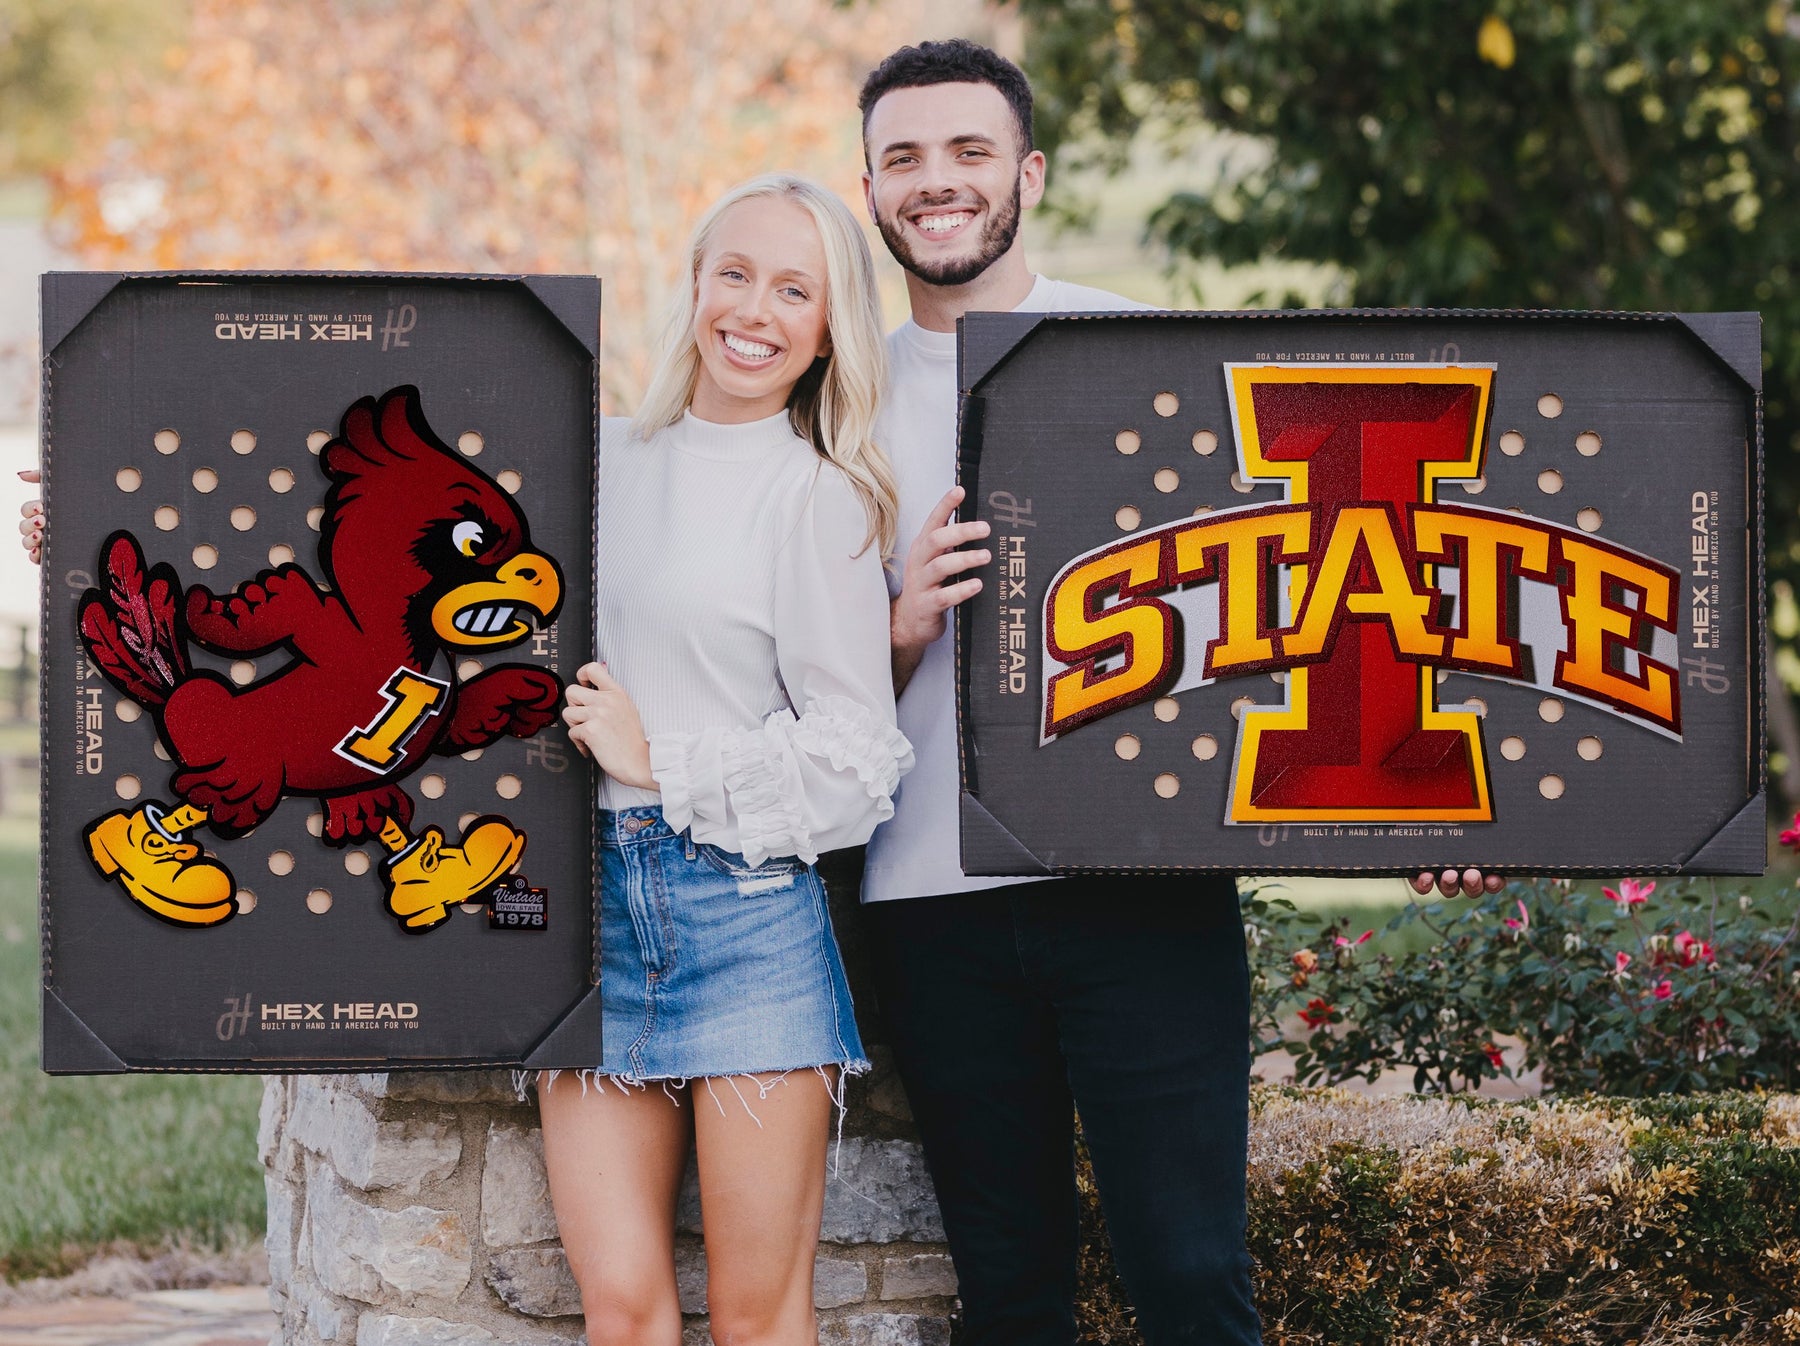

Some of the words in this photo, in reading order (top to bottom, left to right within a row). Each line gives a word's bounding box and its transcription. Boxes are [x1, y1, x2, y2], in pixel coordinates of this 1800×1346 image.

[214, 313, 230, 322] YOU
[234, 313, 250, 322] FOR
[254, 313, 289, 322] AMERICA
[293, 313, 303, 322] IN
[308, 313, 328, 322] HAND
[333, 313, 343, 322] BY
[348, 313, 373, 322] BUILT
[215, 323, 300, 340] HEAD
[310, 324, 372, 341] HEX
[1255, 352, 1271, 361] YOU
[1275, 352, 1291, 361] FOR
[1296, 352, 1330, 361] AMERICA
[1335, 352, 1345, 361] IN
[1350, 352, 1370, 361] HAND
[1375, 352, 1385, 361] BY
[1390, 352, 1415, 361] BUILT
[1711, 491, 1720, 506] YOU
[1711, 510, 1720, 526] FOR
[1692, 491, 1709, 577] HEAD
[999, 536, 1007, 560] BUILT
[1711, 530, 1720, 565] AMERICA
[999, 565, 1007, 576] BY
[1009, 536, 1026, 599] HEX
[1711, 570, 1720, 580] IN
[999, 580, 1007, 600] HAND
[1711, 584, 1720, 604] HAND
[999, 605, 1007, 615] IN
[1692, 586, 1709, 649] HEX
[1711, 609, 1720, 619] BY
[1043, 501, 1684, 738] STATE
[550, 619, 559, 644] AMER
[999, 620, 1007, 654] AMERICA
[1711, 623, 1720, 649] BUILT
[550, 648, 559, 658] IN
[1009, 608, 1026, 694] HEAD
[75, 660, 83, 681] HAND
[999, 659, 1007, 674] FOR
[75, 685, 83, 695] IN
[999, 679, 1007, 694] YOU
[75, 700, 83, 735] AMERICA
[86, 688, 103, 775] HEAD
[75, 739, 83, 755] FOR
[75, 759, 83, 775] YOU
[1304, 829, 1328, 837] BUILT
[1334, 829, 1344, 837] BY
[1349, 829, 1369, 837] HAND
[1374, 829, 1384, 837] IN
[1389, 829, 1424, 837] AMERICA
[1429, 829, 1444, 837] FOR
[1449, 829, 1464, 837] YOU
[493, 888, 543, 904] Vintage
[497, 913, 543, 925] 1978
[261, 1003, 324, 1020] HEX
[333, 1002, 419, 1019] HEAD
[261, 1021, 286, 1030] BUILT
[291, 1021, 300, 1030] BY
[305, 1021, 325, 1030] HAND
[331, 1021, 340, 1030] IN
[345, 1021, 379, 1030] AMERICA
[384, 1021, 399, 1030] FOR
[404, 1021, 419, 1030] YOU
